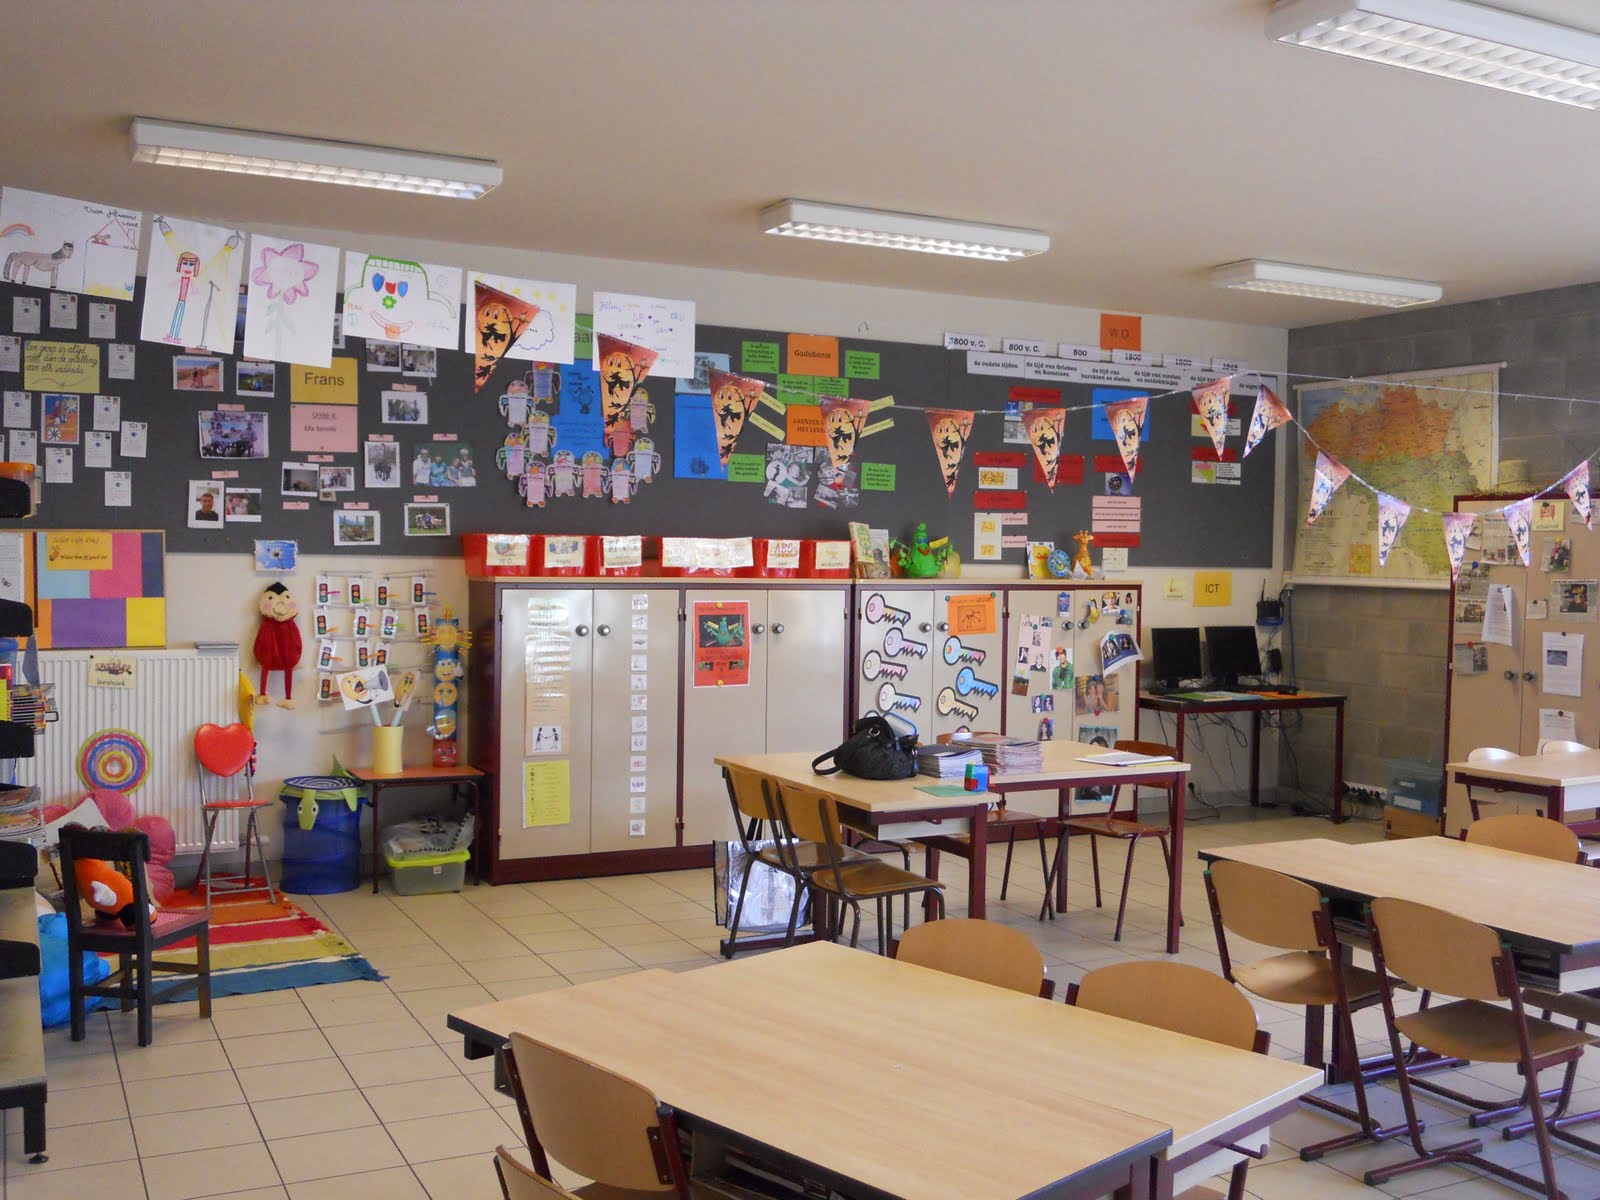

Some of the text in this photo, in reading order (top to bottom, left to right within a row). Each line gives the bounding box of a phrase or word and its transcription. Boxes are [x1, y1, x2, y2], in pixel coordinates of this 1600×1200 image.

[948, 336, 969, 347] 3800
[1008, 343, 1024, 352] 800
[794, 349, 832, 359] Godsdienst
[1001, 361, 1018, 369] tijden
[1034, 362, 1044, 370] tijd
[304, 372, 345, 387] Frans
[1205, 583, 1220, 593] ICT
[96, 678, 125, 687] leeshoek
